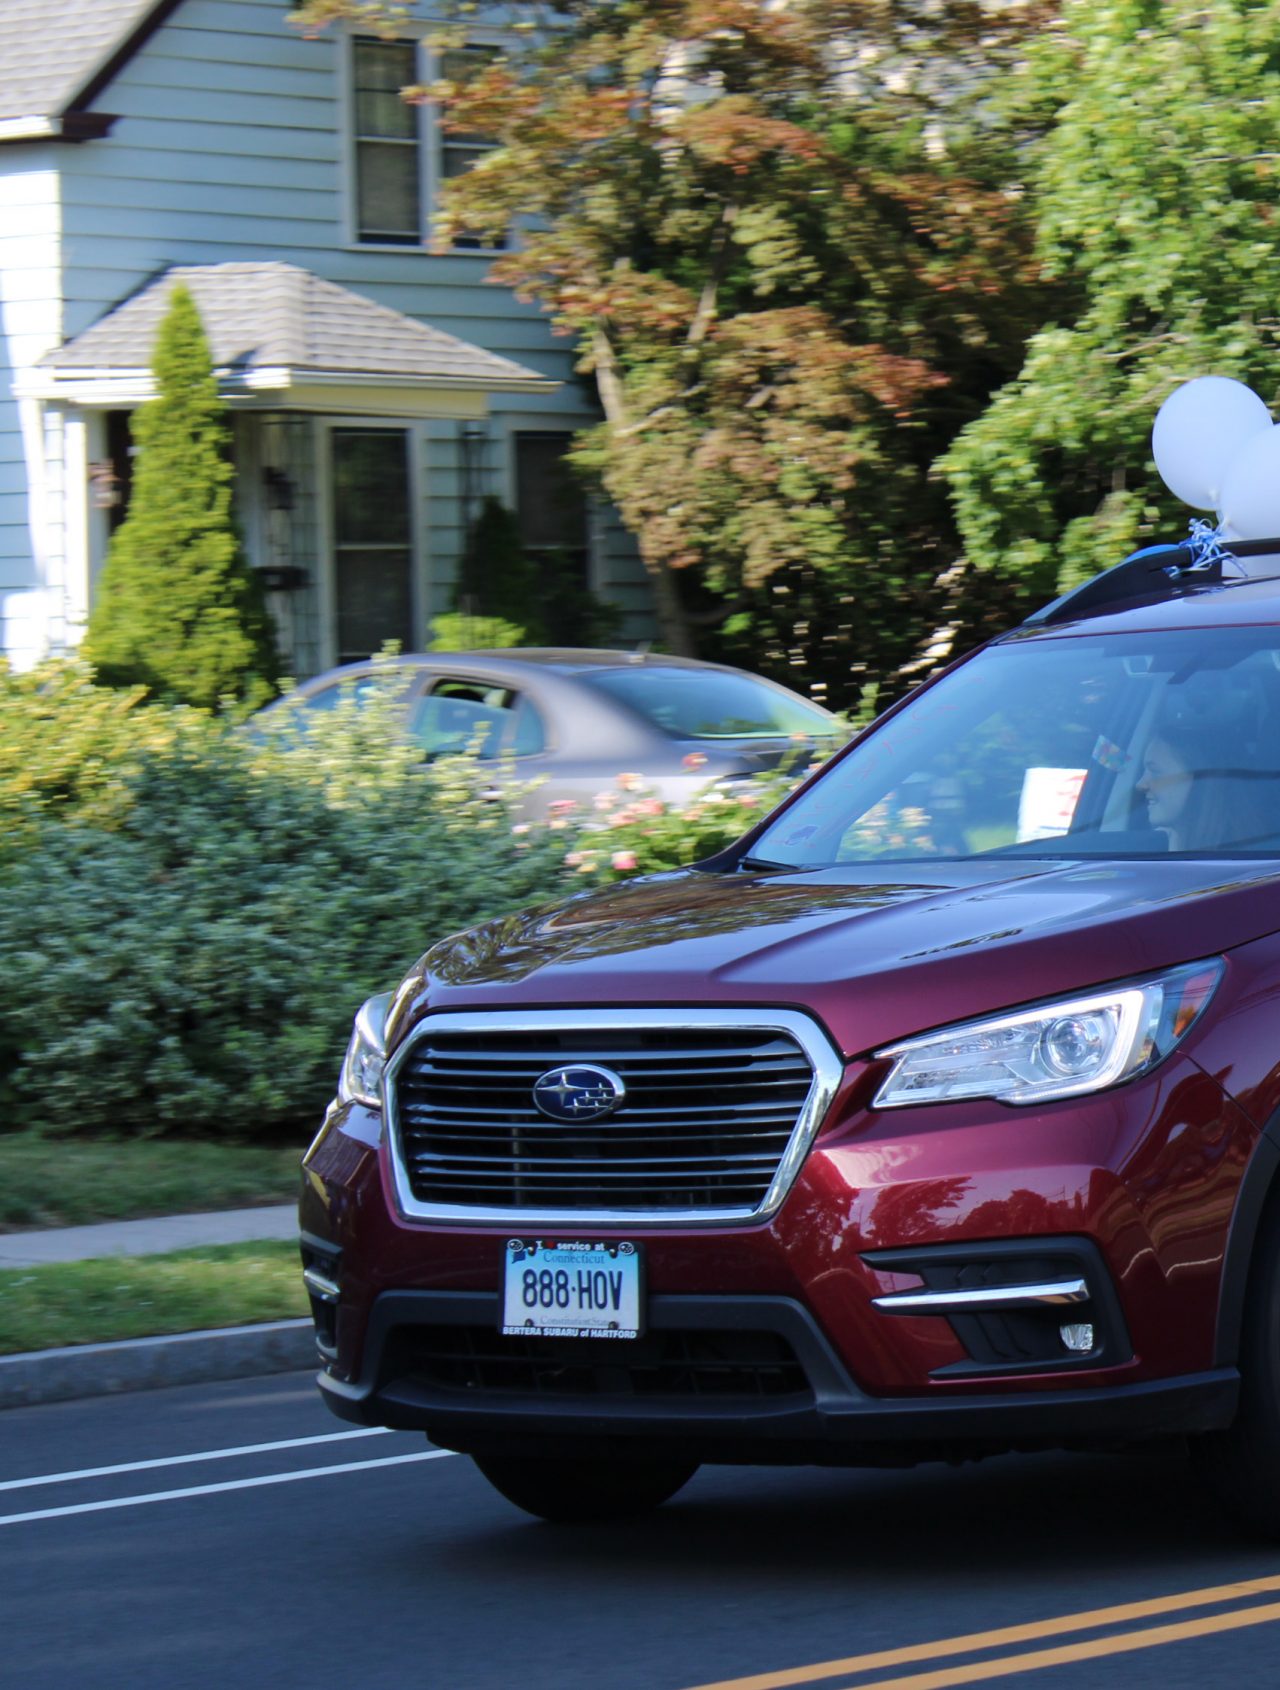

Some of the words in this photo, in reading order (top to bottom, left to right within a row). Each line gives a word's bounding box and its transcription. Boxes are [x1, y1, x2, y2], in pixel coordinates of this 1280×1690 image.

[557, 1241, 591, 1251] service
[594, 1242, 605, 1251] at
[543, 1250, 605, 1264] Connecticut
[503, 1326, 541, 1336] BERTERA
[543, 1327, 579, 1337] SUBARU
[590, 1329, 637, 1340] HARTFORD
